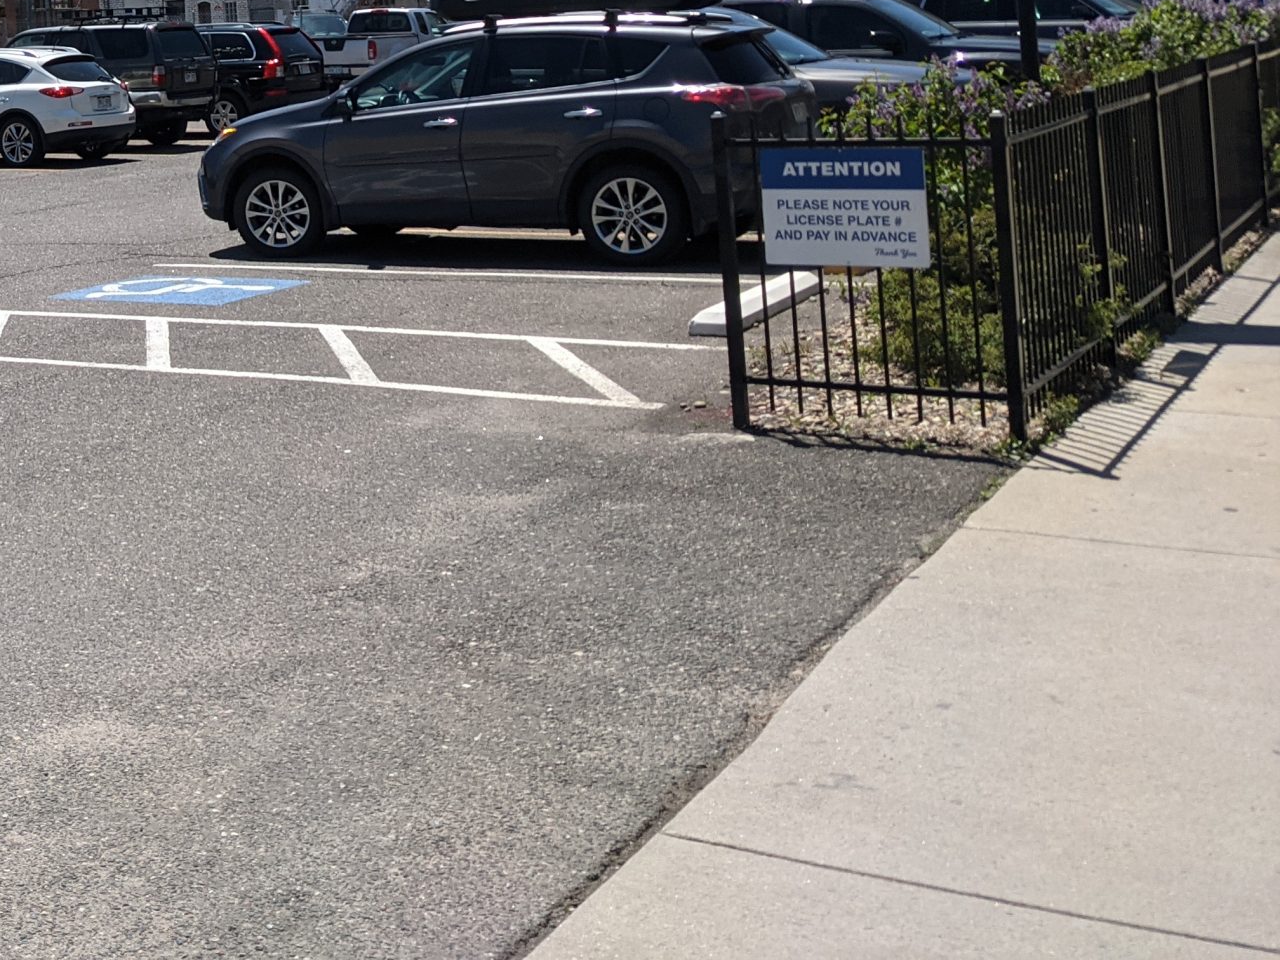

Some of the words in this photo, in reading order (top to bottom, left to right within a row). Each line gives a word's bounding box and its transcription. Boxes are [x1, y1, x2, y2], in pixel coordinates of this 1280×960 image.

[782, 161, 901, 177] ATTENTION
[776, 198, 829, 210] PLEASE
[832, 199, 870, 211] NOTE
[872, 199, 910, 211] YOUR
[786, 214, 844, 226] LICENSE
[847, 215, 891, 227] PLATE
[894, 217, 902, 227] #
[775, 229, 803, 241] AND
[806, 230, 830, 241] PAY
[834, 230, 848, 241] IN
[851, 231, 917, 243] ADVANCE
[874, 247, 899, 257] Thank
[900, 248, 918, 259] You
